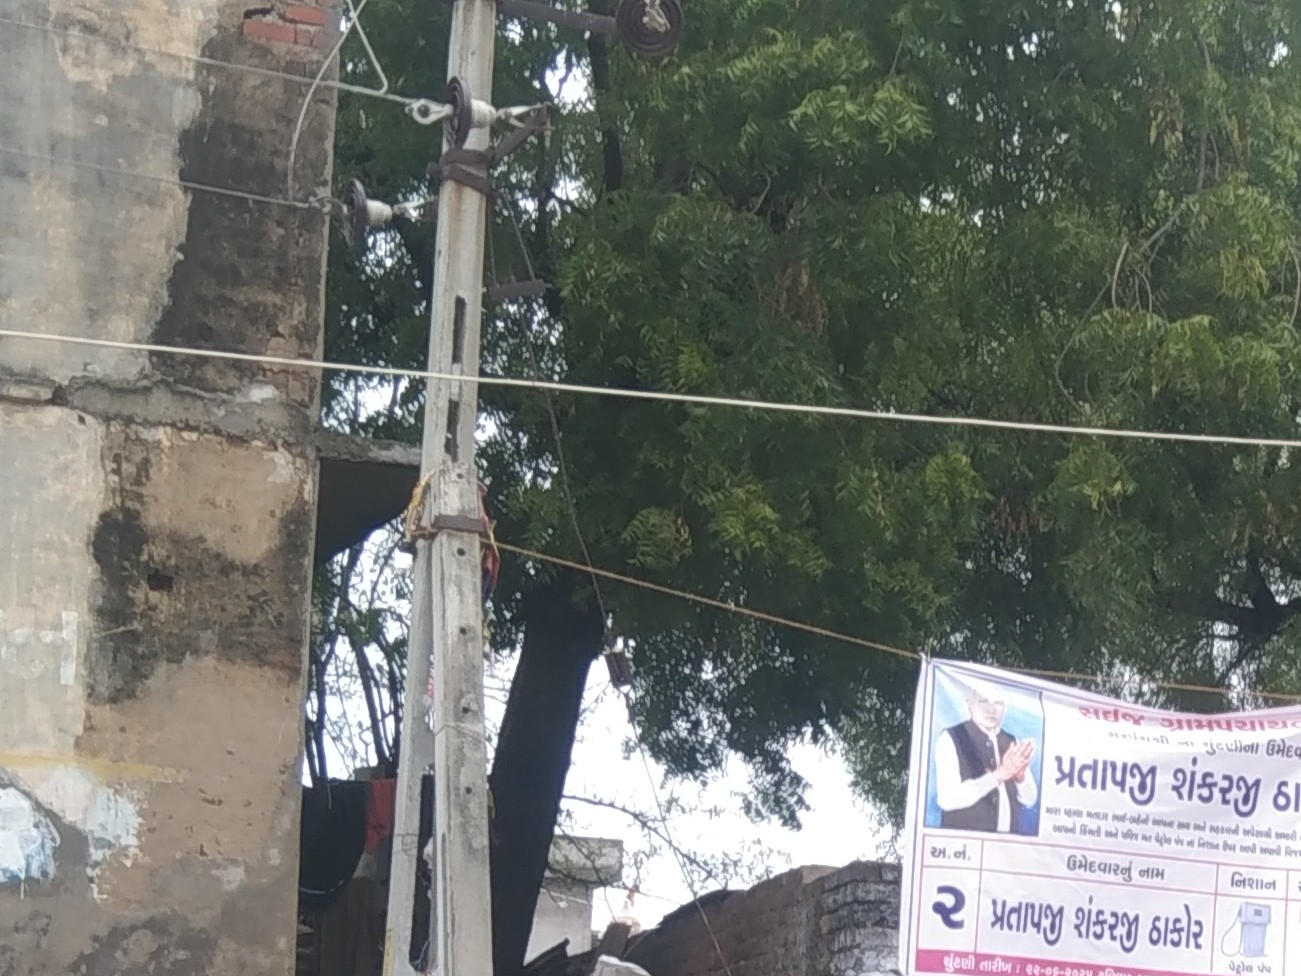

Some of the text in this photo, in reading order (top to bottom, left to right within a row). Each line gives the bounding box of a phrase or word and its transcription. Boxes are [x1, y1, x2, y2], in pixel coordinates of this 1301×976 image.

[1054, 755, 1157, 806] પ્રતાપજી
[1171, 756, 1262, 817] શંકરજી
[1066, 855, 1165, 882] ઉમેદવારનું નામ
[1230, 871, 1277, 891] નિશાન
[932, 885, 966, 929] ૨
[991, 895, 1204, 953] પ્રતાપજી શંકરજી ઠાકોર
[979, 956, 1012, 972] તારીખ
[1229, 960, 1271, 975] પેટ્રોલ પંપ
